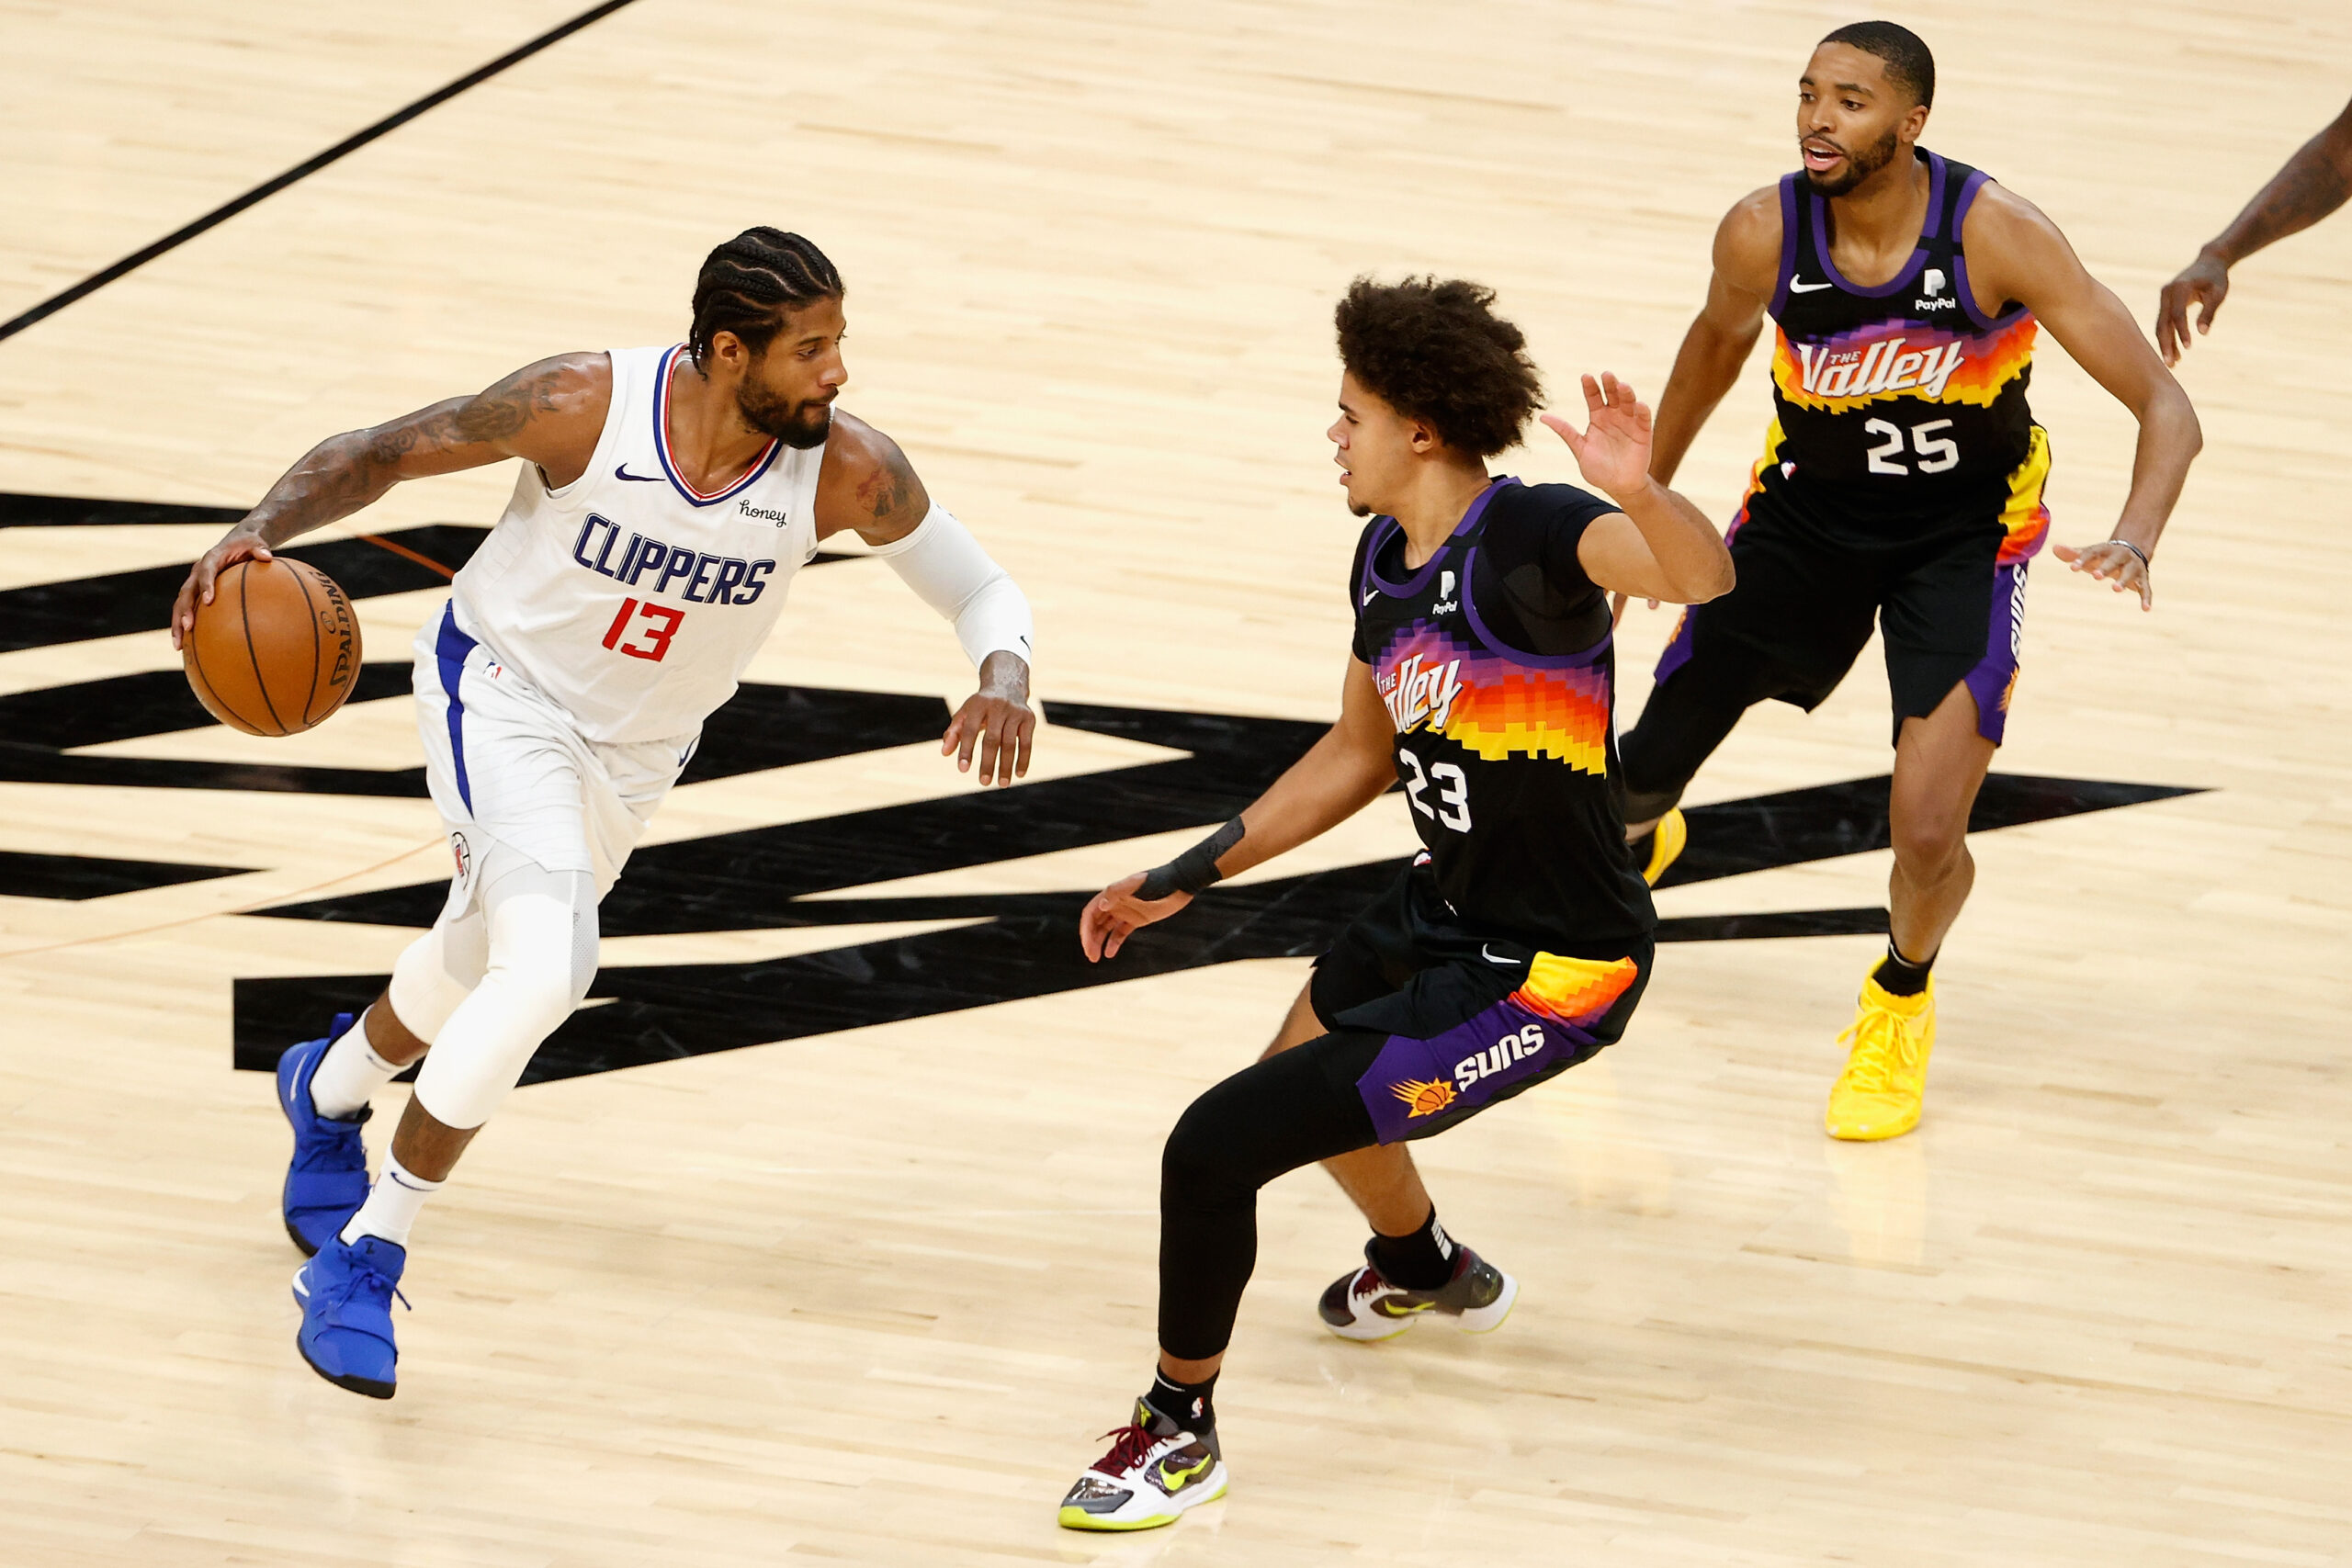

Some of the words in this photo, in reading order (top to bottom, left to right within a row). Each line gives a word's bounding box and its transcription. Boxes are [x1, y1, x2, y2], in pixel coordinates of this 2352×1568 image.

[1915, 297, 1956, 311] PayPal
[1797, 337, 1965, 398] Valley
[1829, 350, 1861, 365] THE
[1864, 417, 1960, 476] 25
[739, 500, 786, 528] honey
[572, 512, 776, 605] CLIPPERS
[308, 570, 353, 687] SPALDING
[601, 597, 685, 662] 13
[1431, 600, 1458, 615] PayPal
[1380, 671, 1397, 694] THE
[1398, 748, 1472, 833] 23
[1453, 1023, 1545, 1092] SUNS
